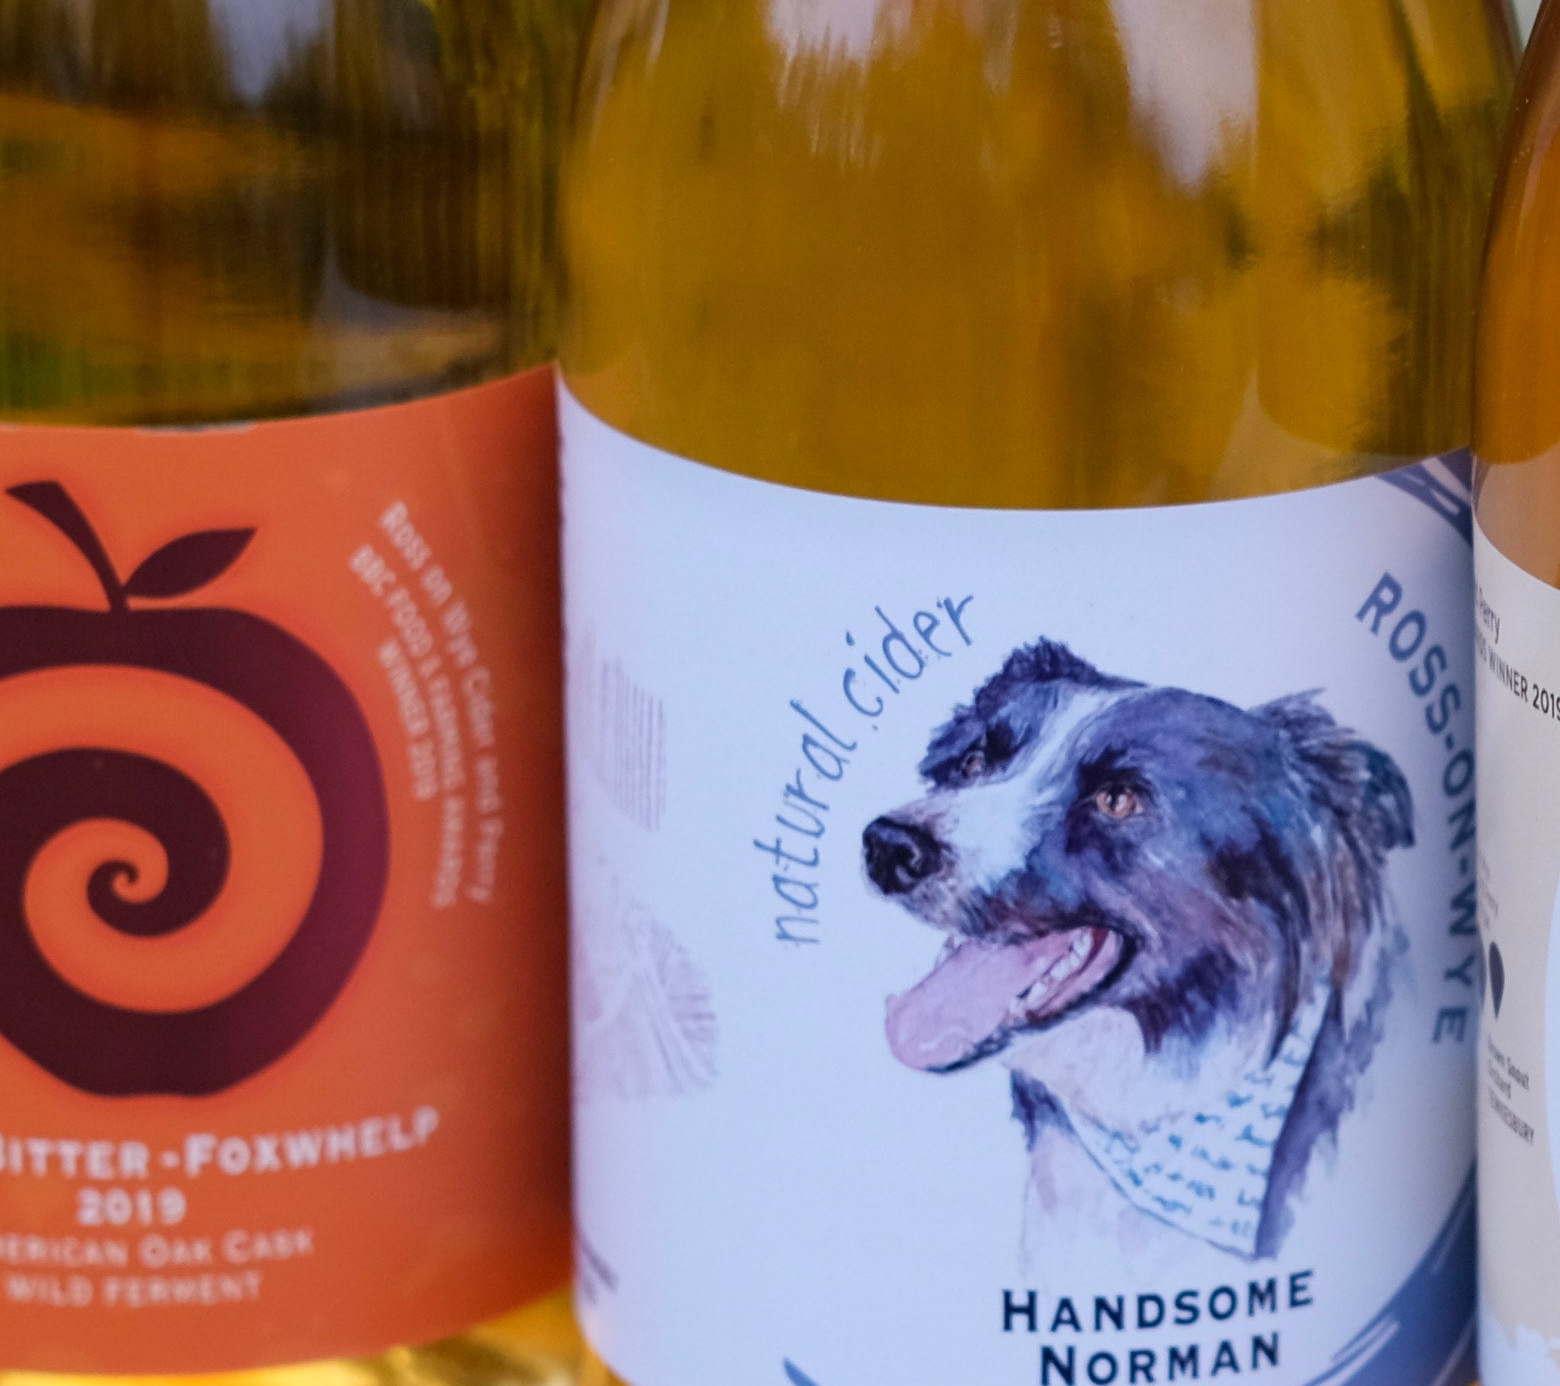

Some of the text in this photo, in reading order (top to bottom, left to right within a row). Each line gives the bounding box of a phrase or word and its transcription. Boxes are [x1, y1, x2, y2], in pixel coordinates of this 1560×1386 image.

[1489, 647, 1529, 703] WINNER
[752, 595, 974, 944] natural cider
[76, 1186, 187, 1226] 2019
[139, 1233, 212, 1268] OAK
[223, 1227, 315, 1264] CASK
[6, 1270, 263, 1307] WILD FERMENT
[1002, 1269, 1314, 1333] HANDSOME
